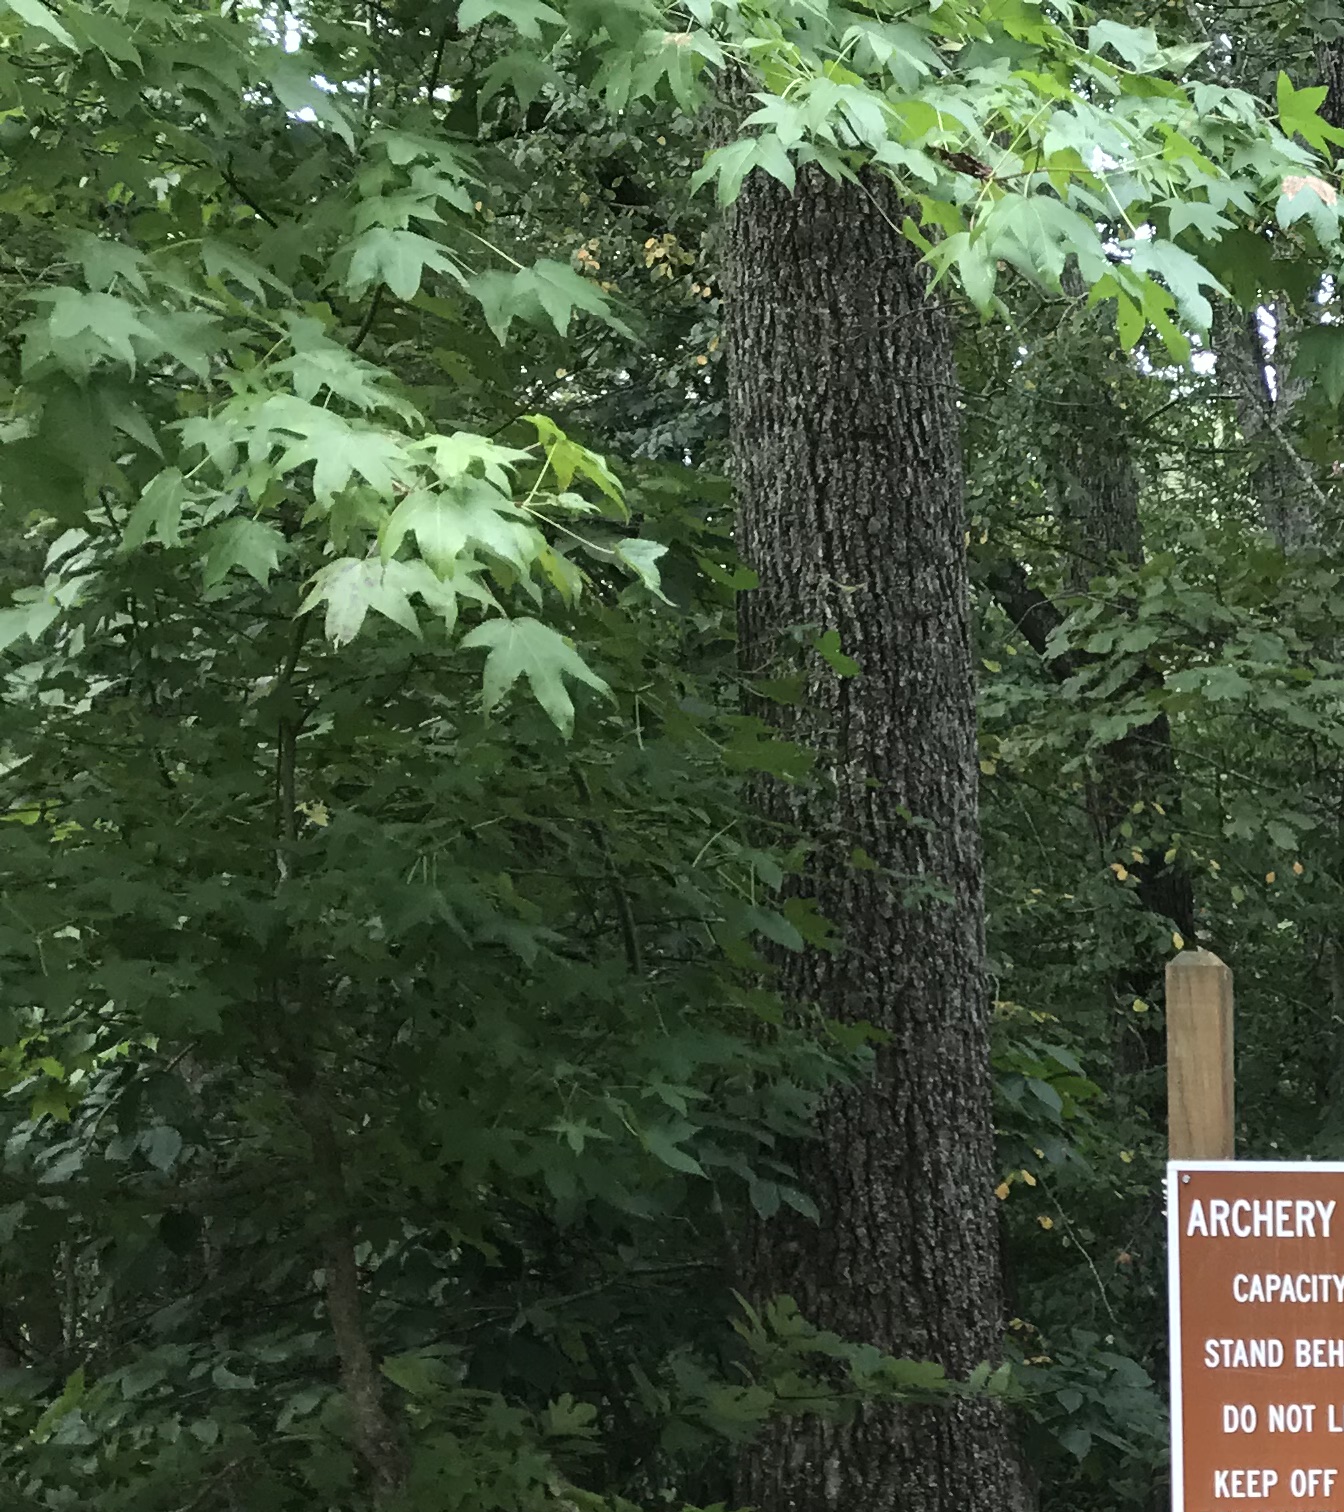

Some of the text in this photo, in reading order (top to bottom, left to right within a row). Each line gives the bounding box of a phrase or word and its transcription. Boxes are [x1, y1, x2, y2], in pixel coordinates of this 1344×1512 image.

[1187, 1199, 1336, 1238] ARCHERY
[1205, 1339, 1283, 1368] STAND
[1223, 1405, 1256, 1433] DO
[1269, 1404, 1316, 1433] NOT
[1215, 1470, 1278, 1498] KEEP
[1290, 1469, 1337, 1497] OFF
